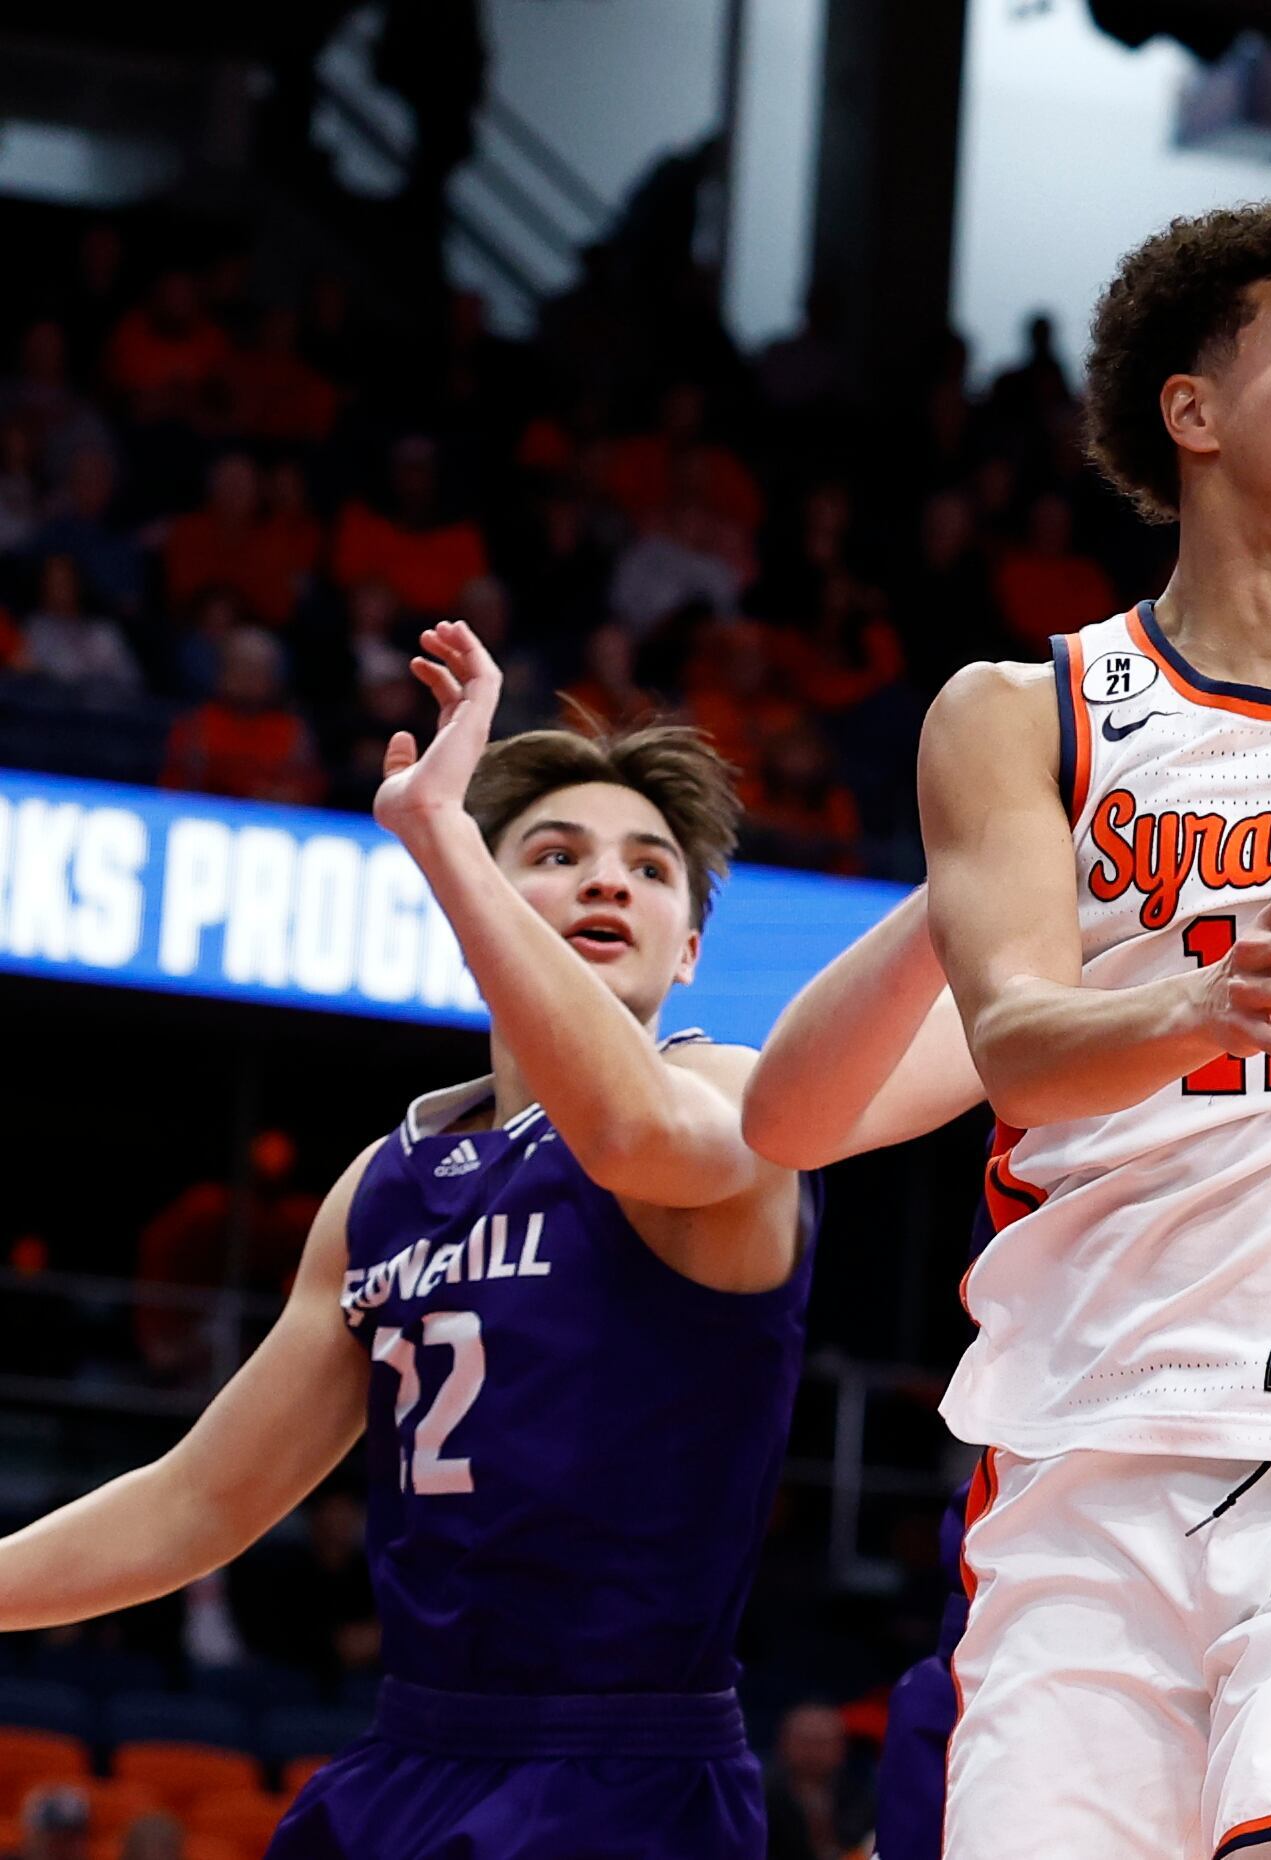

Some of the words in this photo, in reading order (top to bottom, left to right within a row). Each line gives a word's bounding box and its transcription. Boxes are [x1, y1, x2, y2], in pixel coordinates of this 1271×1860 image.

[1106, 657, 1131, 674] LM
[1105, 672, 1131, 697] 21
[0, 797, 148, 969] KS
